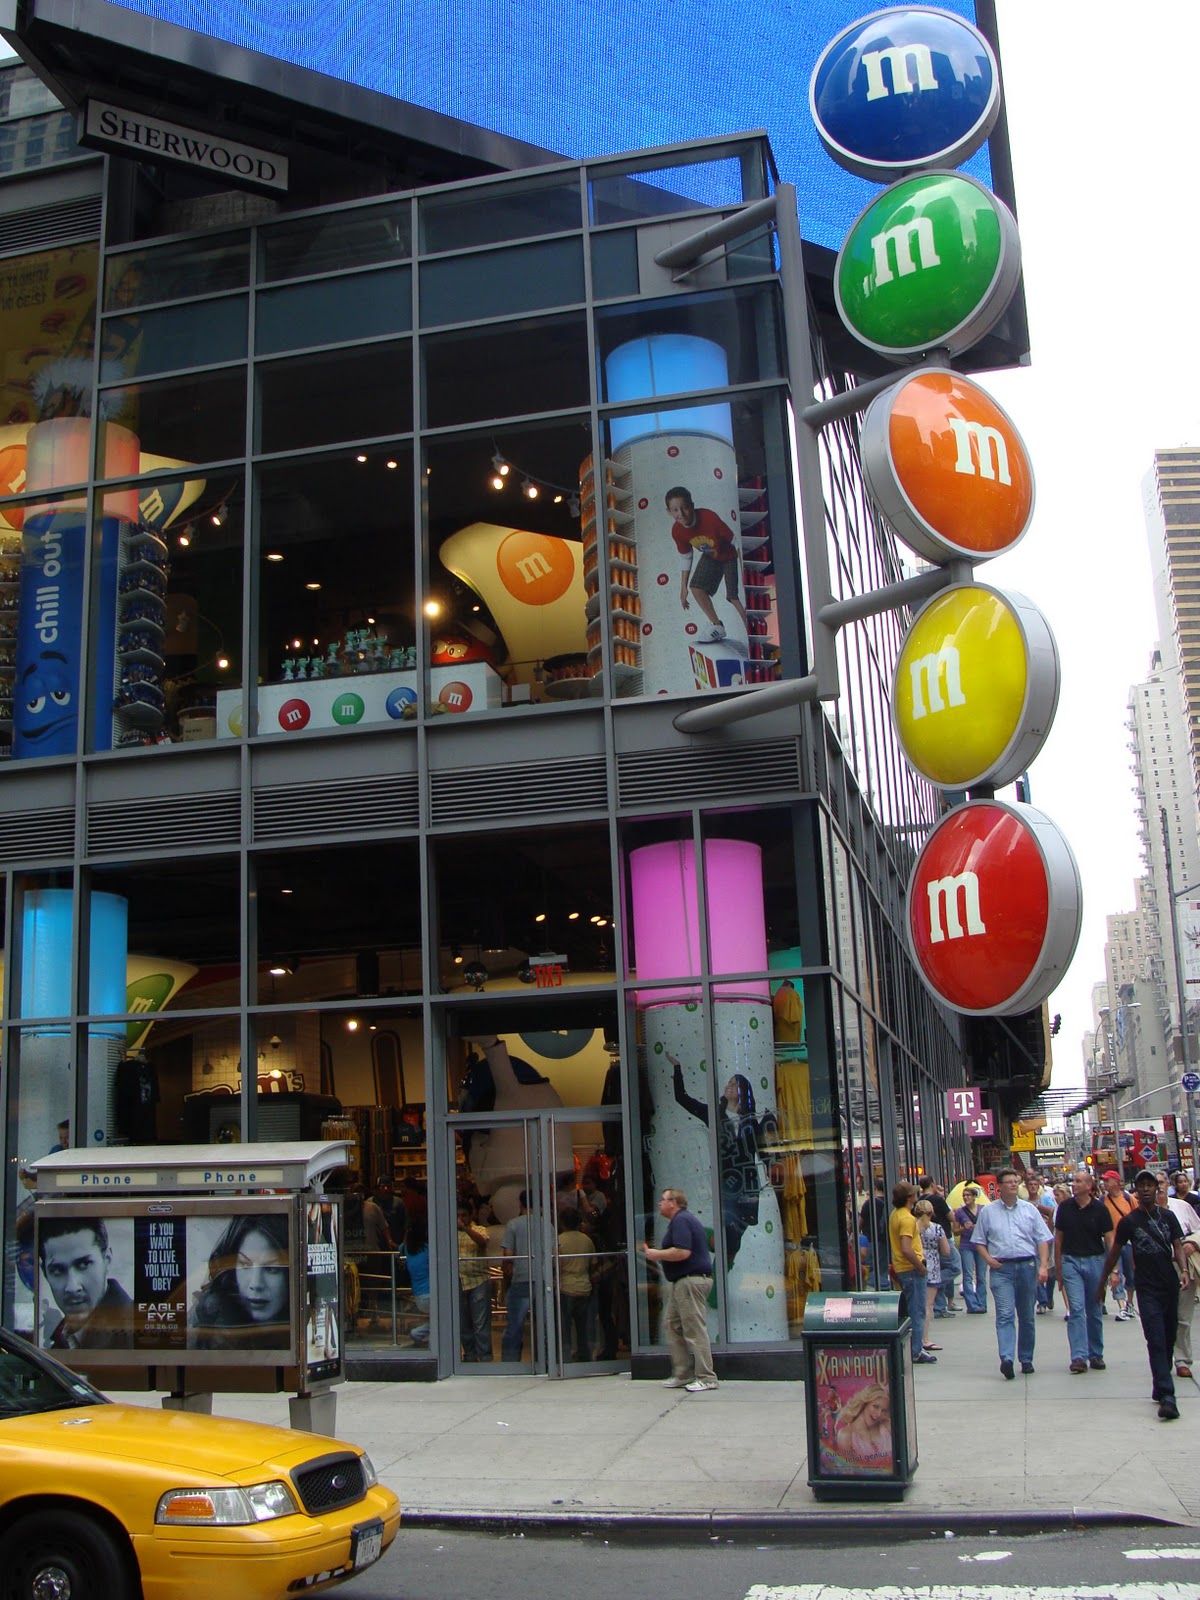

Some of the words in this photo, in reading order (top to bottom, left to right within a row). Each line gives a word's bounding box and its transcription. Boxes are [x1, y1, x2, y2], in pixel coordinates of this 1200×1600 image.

[861, 42, 939, 102] m
[99, 110, 277, 183] SHERWOOD
[870, 215, 941, 288] m
[949, 416, 1013, 487] m
[40, 530, 62, 578] out
[514, 546, 553, 585] m
[34, 585, 60, 644] chill
[909, 644, 967, 720] m
[448, 690, 463, 707] m
[286, 707, 302, 724] m
[341, 703, 356, 716] m
[926, 870, 987, 944] m
[953, 1091, 975, 1117] T
[81, 1174, 132, 1185] Phone
[203, 1172, 256, 1183] Phone
[149, 1222, 157, 1236] IF
[158, 1222, 174, 1236] YOU
[150, 1236, 173, 1250] WANT
[148, 1250, 158, 1263] TO
[159, 1250, 176, 1263] LIVE
[307, 1252, 336, 1266] FIBERS
[144, 1263, 160, 1277] YOU
[161, 1263, 180, 1277] WILL
[152, 1277, 172, 1291] OBEY
[138, 1303, 185, 1312] EAGLE
[147, 1312, 176, 1321] EYE
[818, 1354, 888, 1386] XANADU
